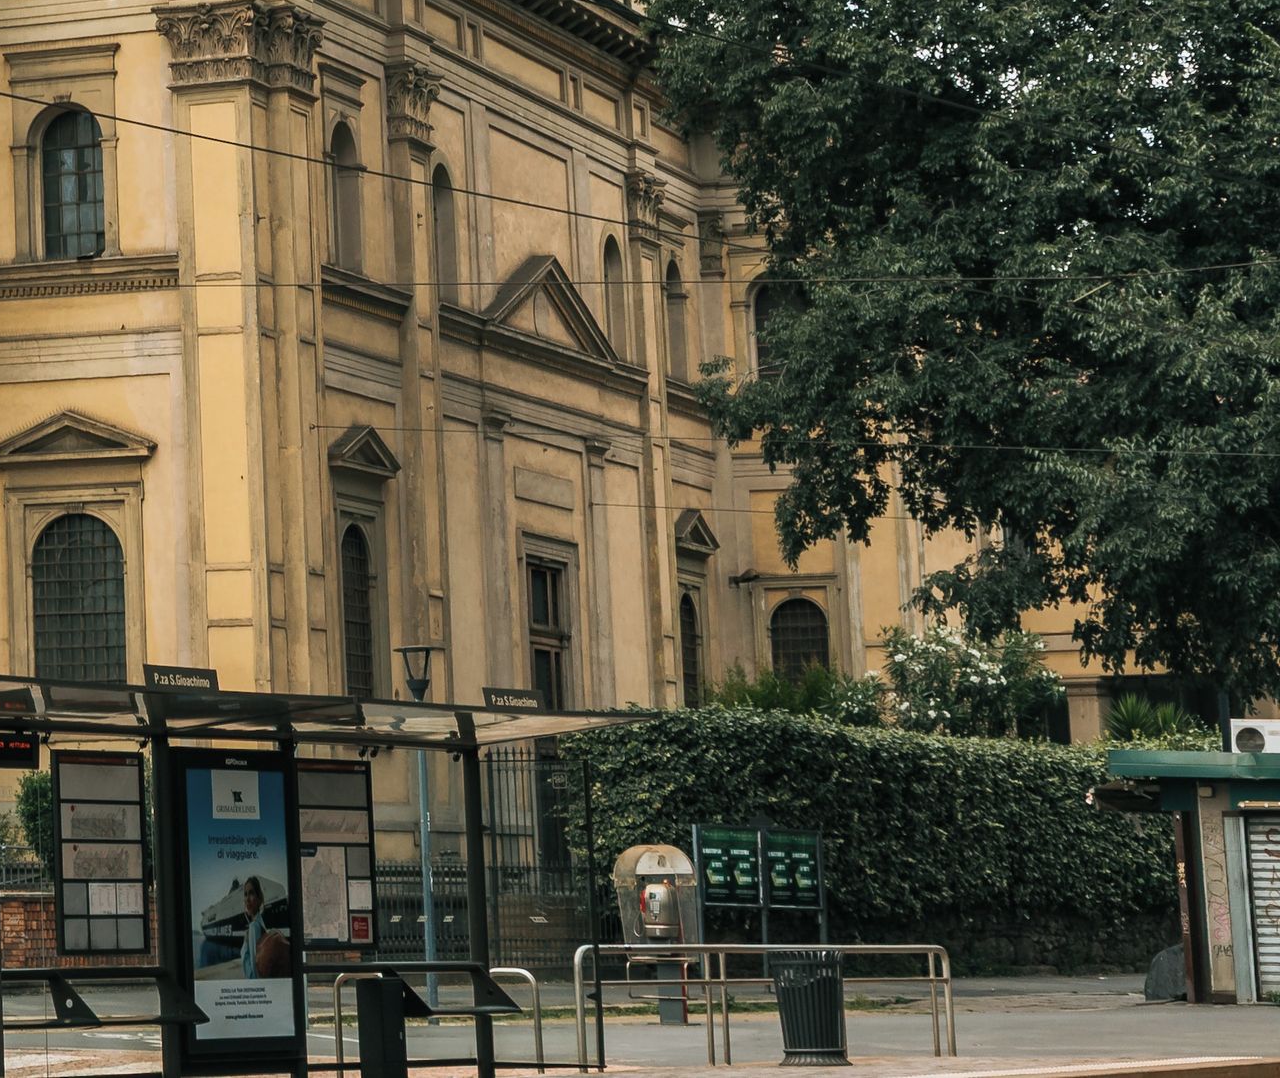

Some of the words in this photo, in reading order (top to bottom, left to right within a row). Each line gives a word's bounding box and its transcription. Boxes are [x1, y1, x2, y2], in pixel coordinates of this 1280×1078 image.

[154, 672, 169, 685] P.za
[208, 835, 245, 844] Irresistibile
[247, 835, 268, 846] voglia
[217, 850, 224, 859] di
[226, 850, 259, 861] viaggiare.
